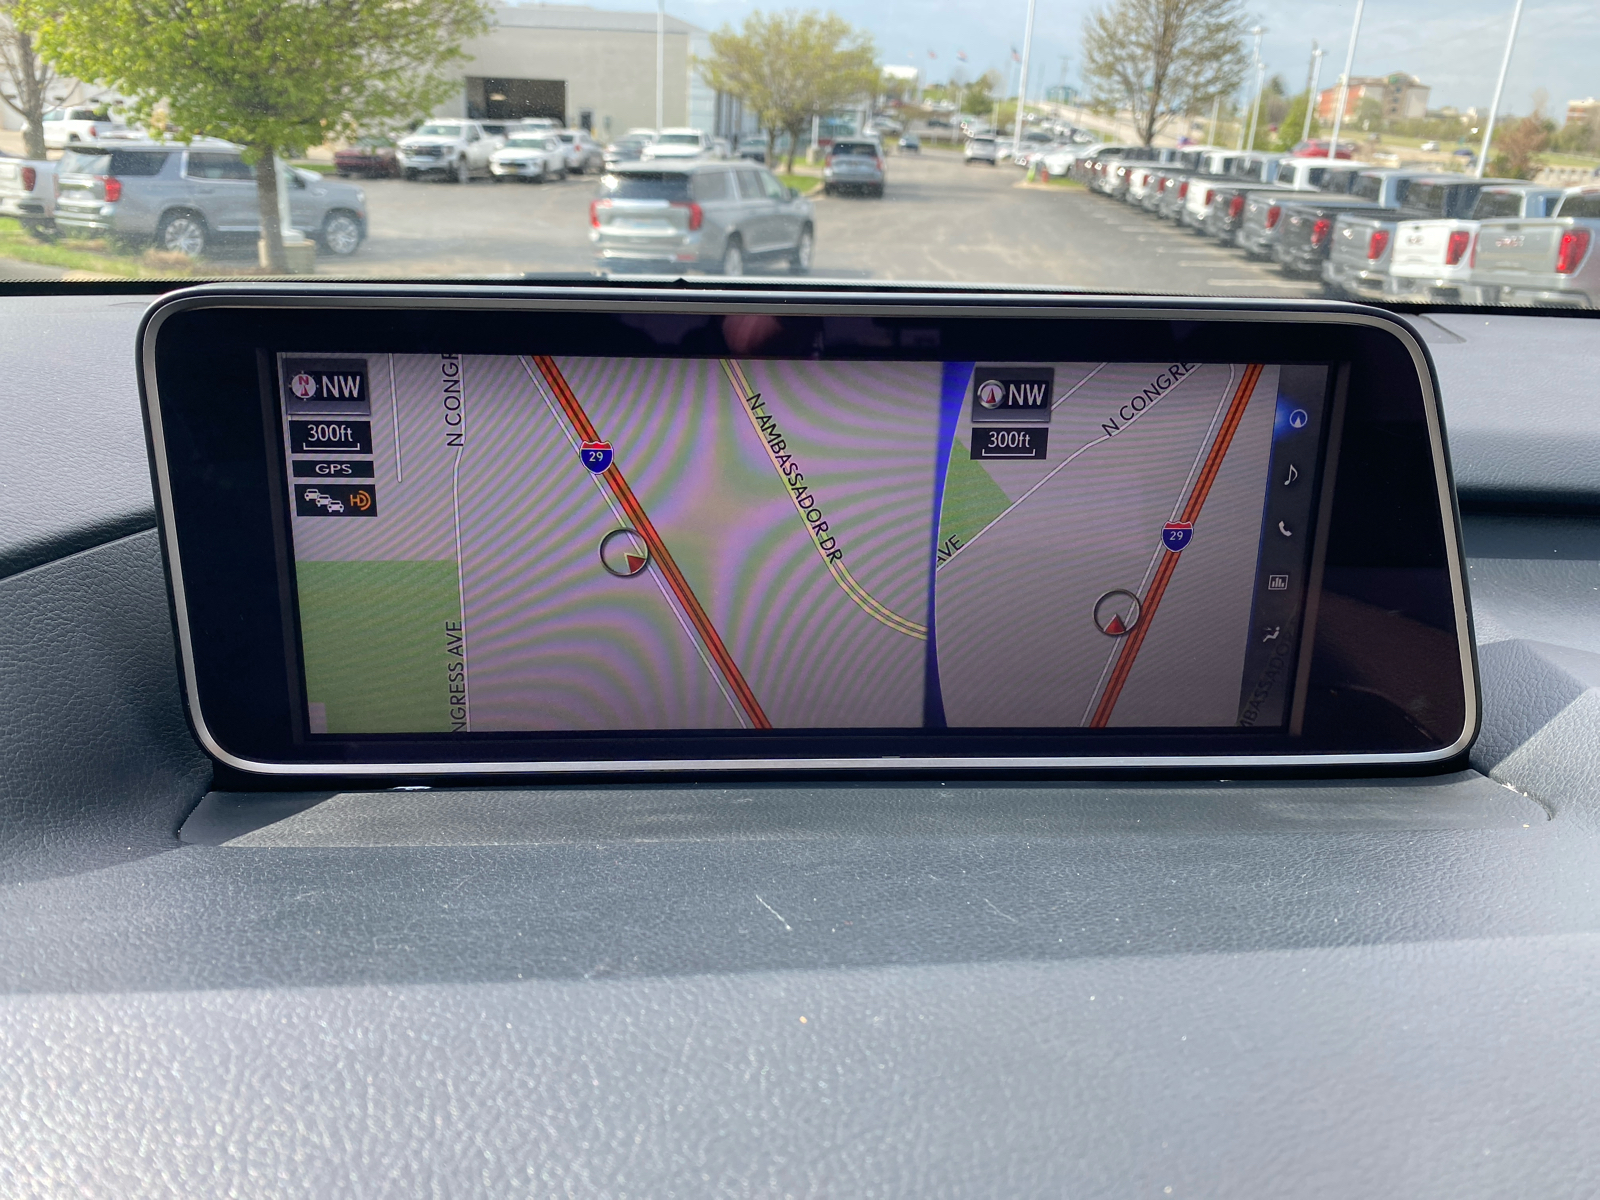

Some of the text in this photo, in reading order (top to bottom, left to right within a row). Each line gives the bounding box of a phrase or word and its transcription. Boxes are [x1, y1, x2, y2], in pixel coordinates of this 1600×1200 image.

[298, 376, 310, 386] N
[321, 375, 361, 398] NW
[1008, 384, 1046, 406] NW
[1101, 362, 1196, 436] N CONGRE
[307, 424, 354, 442] 300ft
[446, 433, 464, 446] N
[988, 431, 1031, 448] 300ft
[589, 451, 604, 462] 29
[315, 463, 352, 475] GPS
[746, 393, 844, 564] N AMBASSADOR DR
[1169, 530, 1184, 541] 29
[445, 621, 464, 657] AVE
